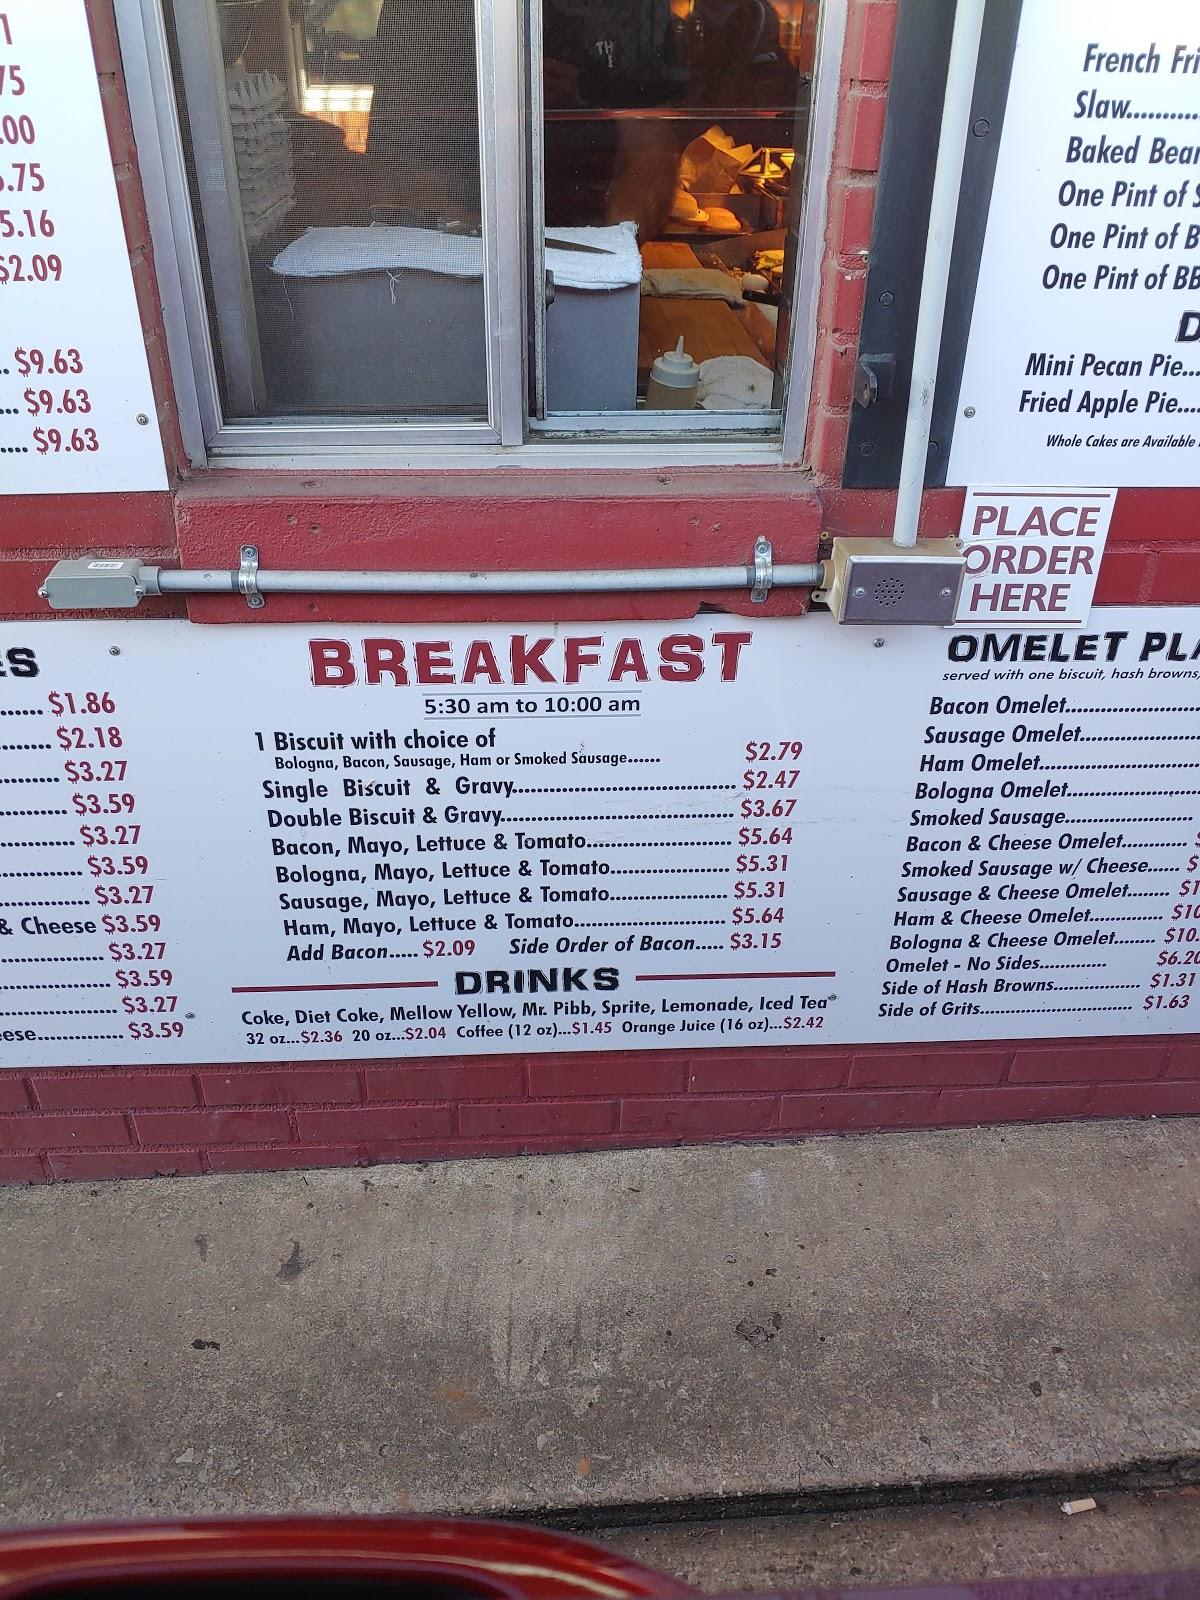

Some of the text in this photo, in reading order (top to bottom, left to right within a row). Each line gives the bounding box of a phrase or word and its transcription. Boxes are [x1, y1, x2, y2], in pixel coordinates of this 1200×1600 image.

[1083, 44, 1160, 73] French
[1066, 135, 1141, 163] Baked
[1059, 180, 1189, 207] One Pint of
[1051, 223, 1180, 249] One Pint of
[1043, 264, 1170, 289] One Pint of
[15, 347, 83, 377] $9.63
[1025, 353, 1142, 376] Mini Pecan
[24, 388, 91, 417] $9.63
[1019, 389, 1138, 418] Fried Apple
[33, 427, 99, 455] $9.63
[1047, 434, 1195, 447] Whole Cakes are Available
[972, 506, 1100, 536] PLACE
[962, 544, 1094, 575] ORDER
[970, 584, 1071, 611] HERE
[947, 630, 1129, 663] OMELET
[308, 631, 753, 689] BREAKFAST
[943, 669, 990, 680] served
[994, 669, 1024, 679] with
[1058, 669, 1105, 680] biscuit,
[1111, 668, 1144, 678] hash
[48, 691, 115, 717] $1.86
[425, 697, 639, 714] 5:30 am to 10:00 am
[930, 697, 988, 714] Bacon
[57, 726, 122, 751] $2.18
[255, 727, 495, 751] 1 Biscuit with choice of
[924, 726, 1005, 748] Sausage
[275, 741, 802, 772] Bologna, Bacon, Sausage, Ham or Smoked $2.79
[920, 755, 964, 772] Ham
[65, 760, 127, 784] $3.27
[263, 769, 800, 803] Single Biscuit & $2.47
[915, 781, 994, 803] Bologna
[72, 793, 134, 816] $3.59
[267, 798, 797, 827] Double Biscuit & $3.67
[910, 808, 984, 826] Smoked
[80, 824, 140, 847] $3.27
[272, 826, 792, 857] Bacon, Mayo, Lettuce & $5.64
[906, 834, 1052, 852] Bacon & Cheese
[88, 855, 148, 877] $3.59
[276, 854, 787, 886] Bologna, Mayo, Lettuce & $5.31
[902, 858, 1083, 879] Smoked Sausage w/
[95, 885, 153, 906] $3.27
[279, 880, 784, 912] Sausage, Mayo, Lettuce & $5.31
[897, 884, 1059, 905] Sausage & Cheese
[21, 916, 96, 934] Cheese
[102, 914, 160, 935] $3.59
[284, 907, 784, 937] Ham, Mayo, Lettuce & $5.64
[894, 909, 1022, 926] Ham & Cheese
[109, 942, 166, 962] $3.27
[287, 932, 781, 961] Add $2.09 Side Order of $3.15
[890, 932, 1047, 953] Bologna & Cheese
[886, 957, 949, 972] Omelet
[967, 957, 990, 971] No
[116, 969, 172, 989] $3.59
[455, 967, 620, 995] DRINKS
[882, 972, 1196, 995] Side of Hash $1.31
[122, 995, 177, 1015] $3.27
[242, 995, 827, 1026] Coke, Diet Coke, Mellow Yellow, Mr. Pibb, Sprite, Lemonade, Iced Tea
[878, 993, 1190, 1017] Side of $1.63
[128, 1021, 183, 1040] $3.59
[247, 1018, 743, 1044] 32 20 Coffee (12 Orange Juice (16
